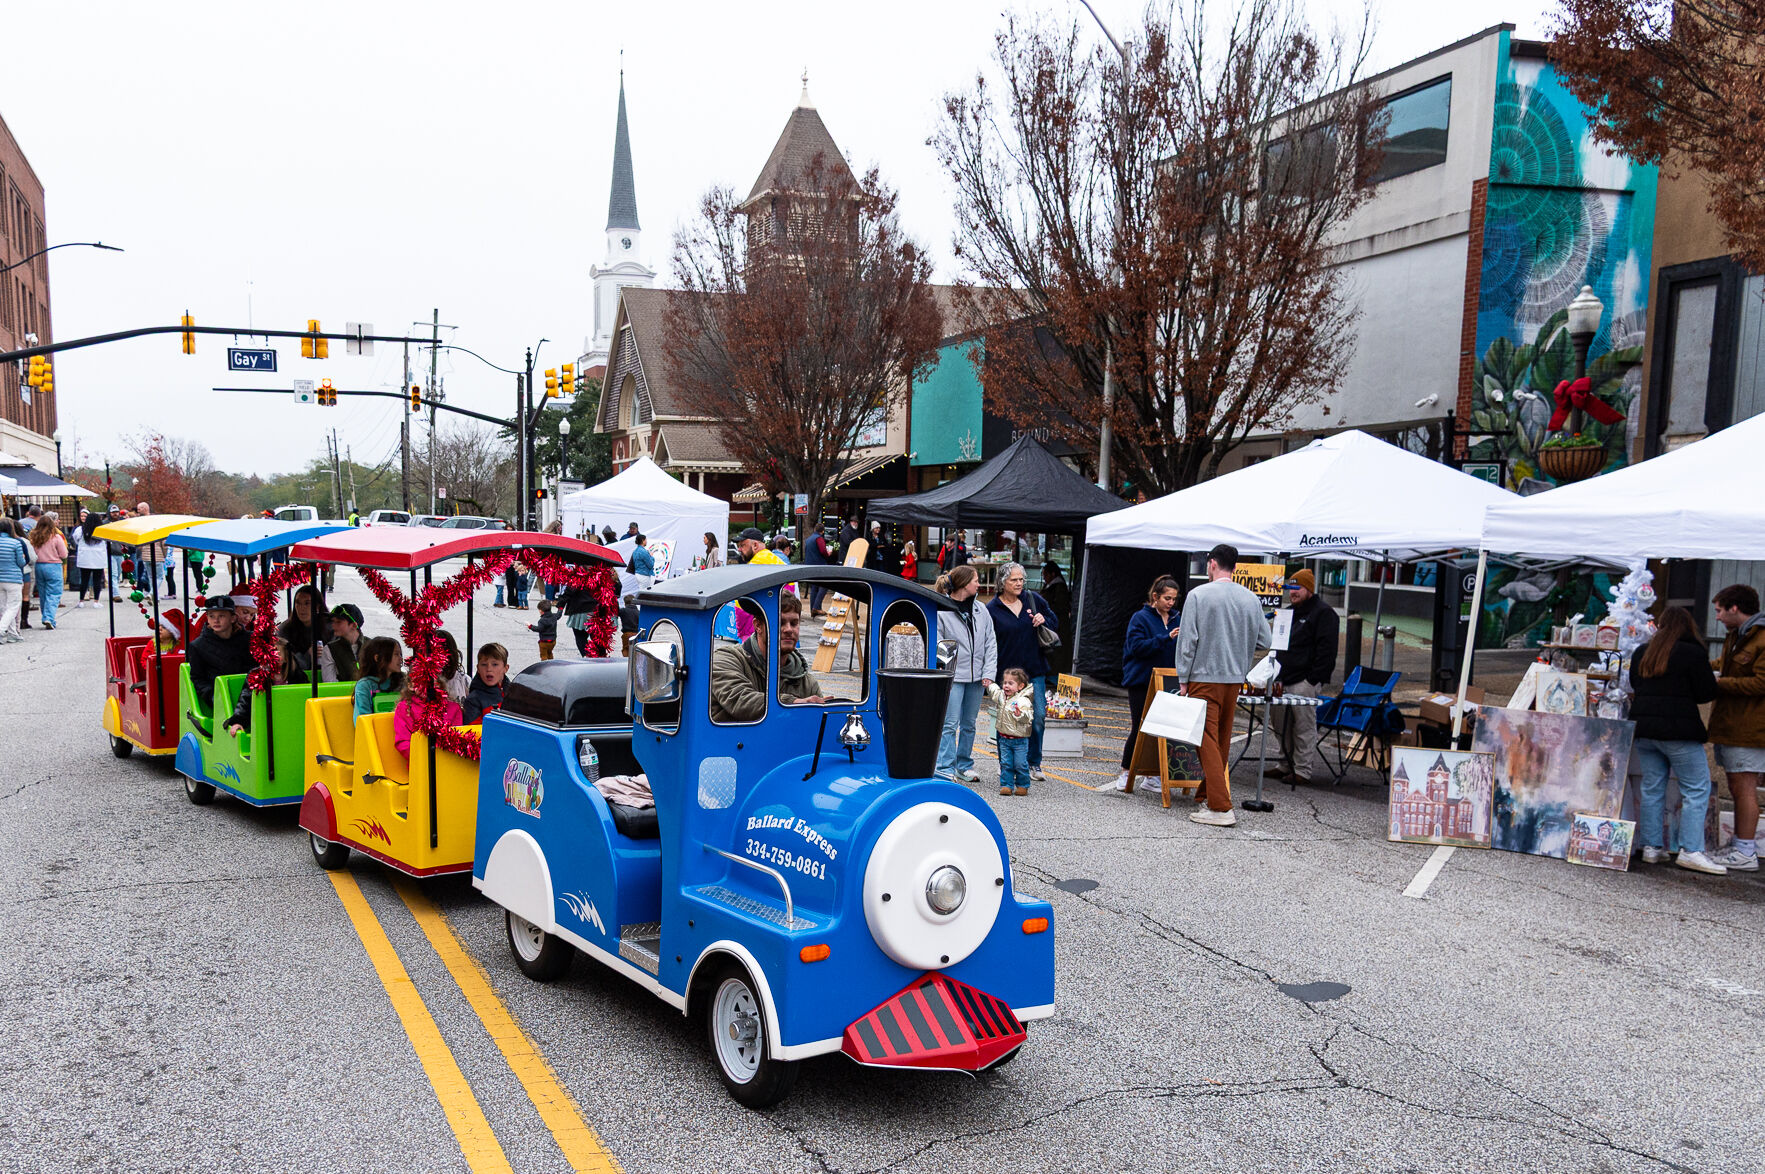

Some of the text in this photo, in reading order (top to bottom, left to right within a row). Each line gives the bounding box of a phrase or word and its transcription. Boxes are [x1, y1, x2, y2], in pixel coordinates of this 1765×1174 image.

[234, 352, 270, 367] Gay St
[1488, 466, 1498, 480] 2
[1299, 534, 1358, 546] Academy
[1467, 577, 1476, 590] P
[746, 814, 838, 861] Ballard Express
[745, 838, 826, 881] 334-759-0861
